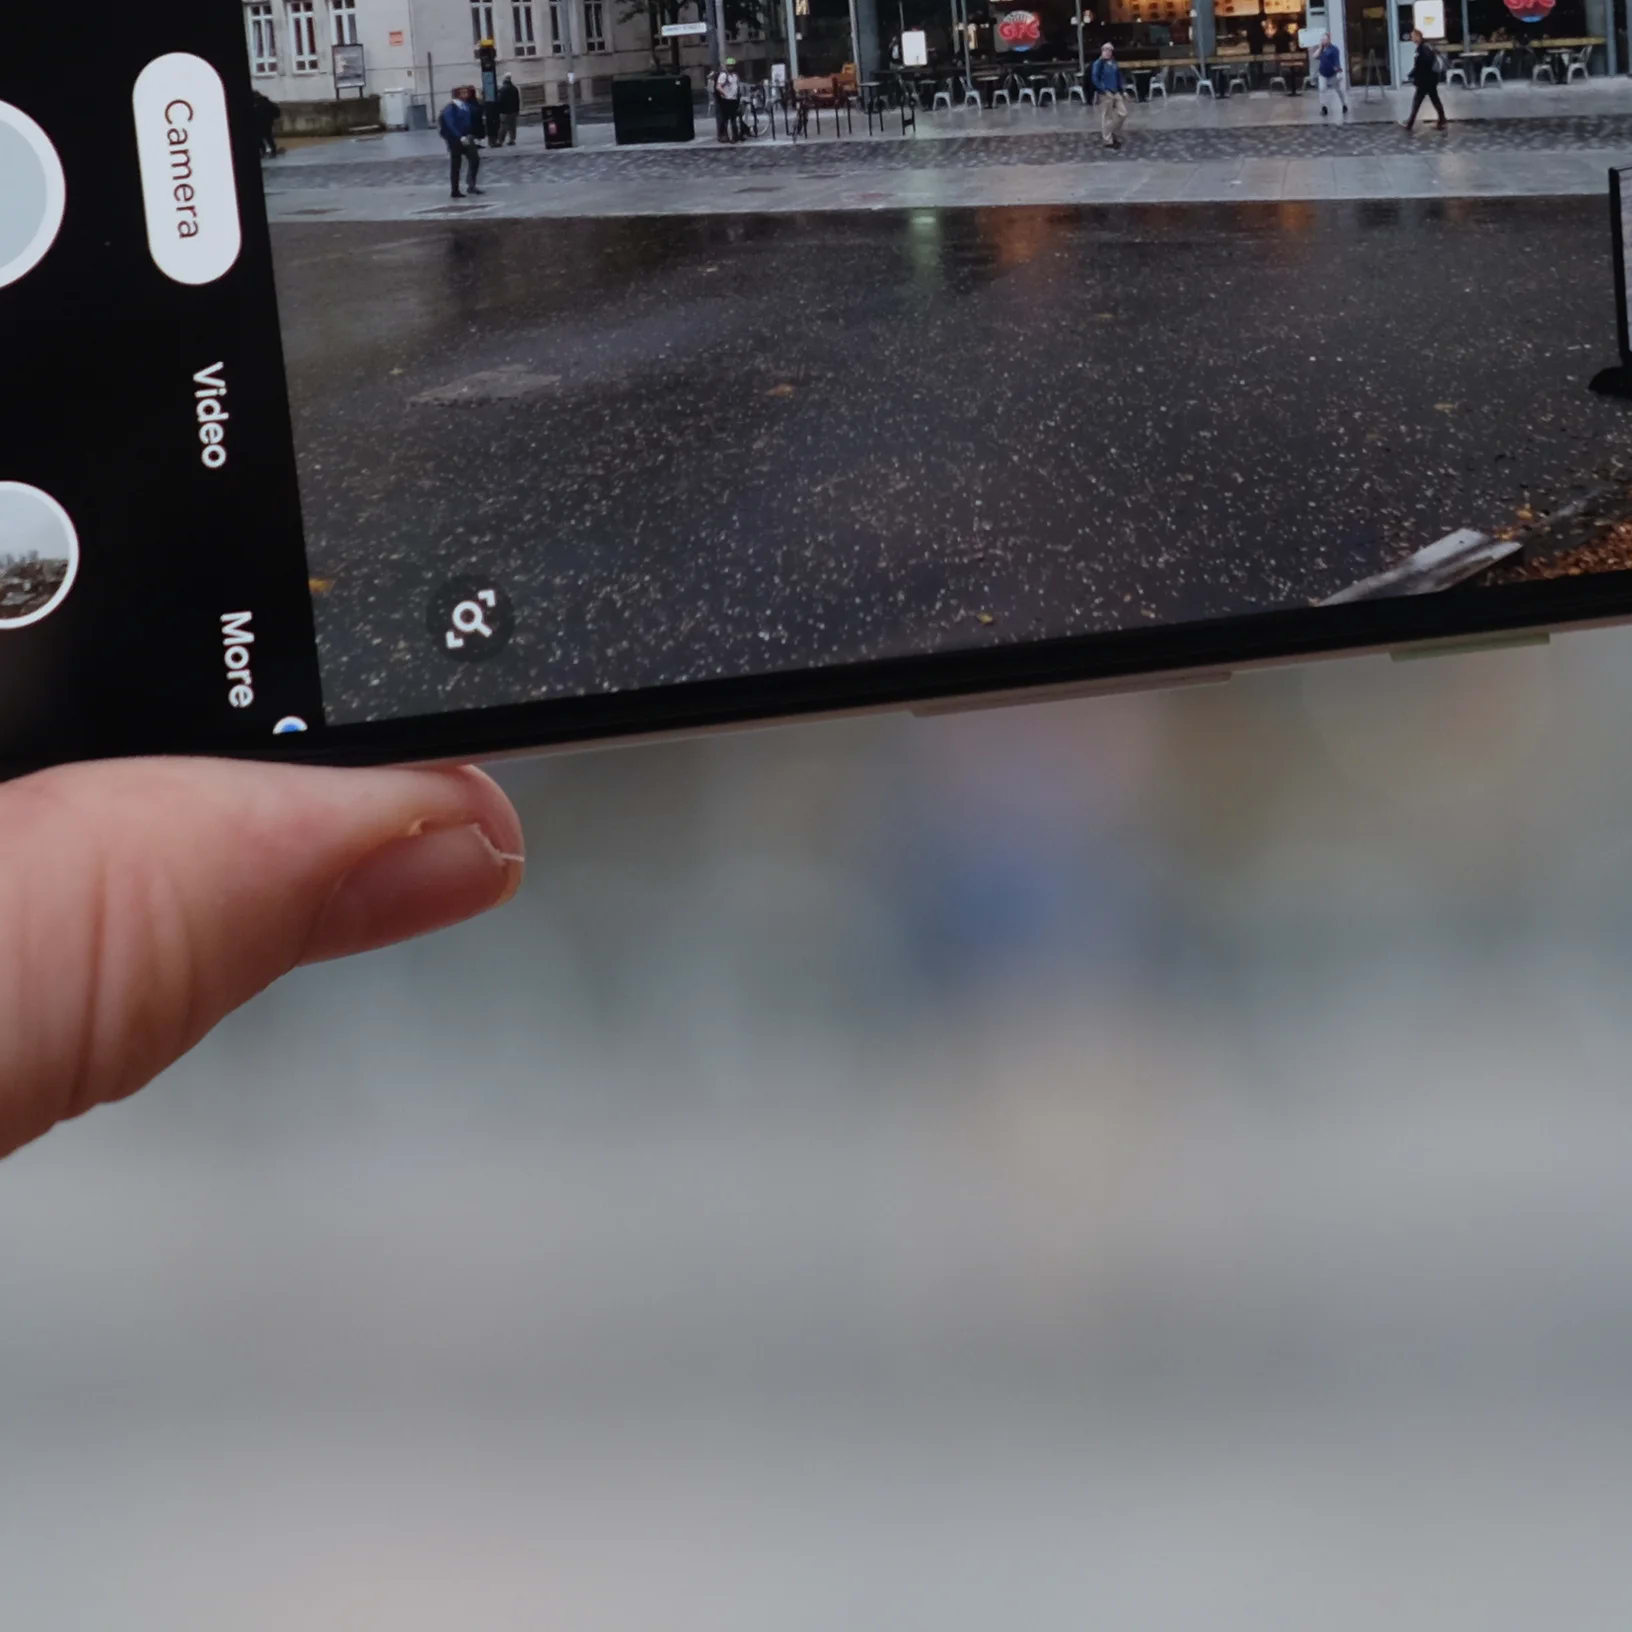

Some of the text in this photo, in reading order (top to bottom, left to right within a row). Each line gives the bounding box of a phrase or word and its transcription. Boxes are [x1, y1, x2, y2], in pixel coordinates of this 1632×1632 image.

[164, 99, 199, 239] Camera
[193, 361, 229, 469] Video
[220, 610, 255, 708] More
